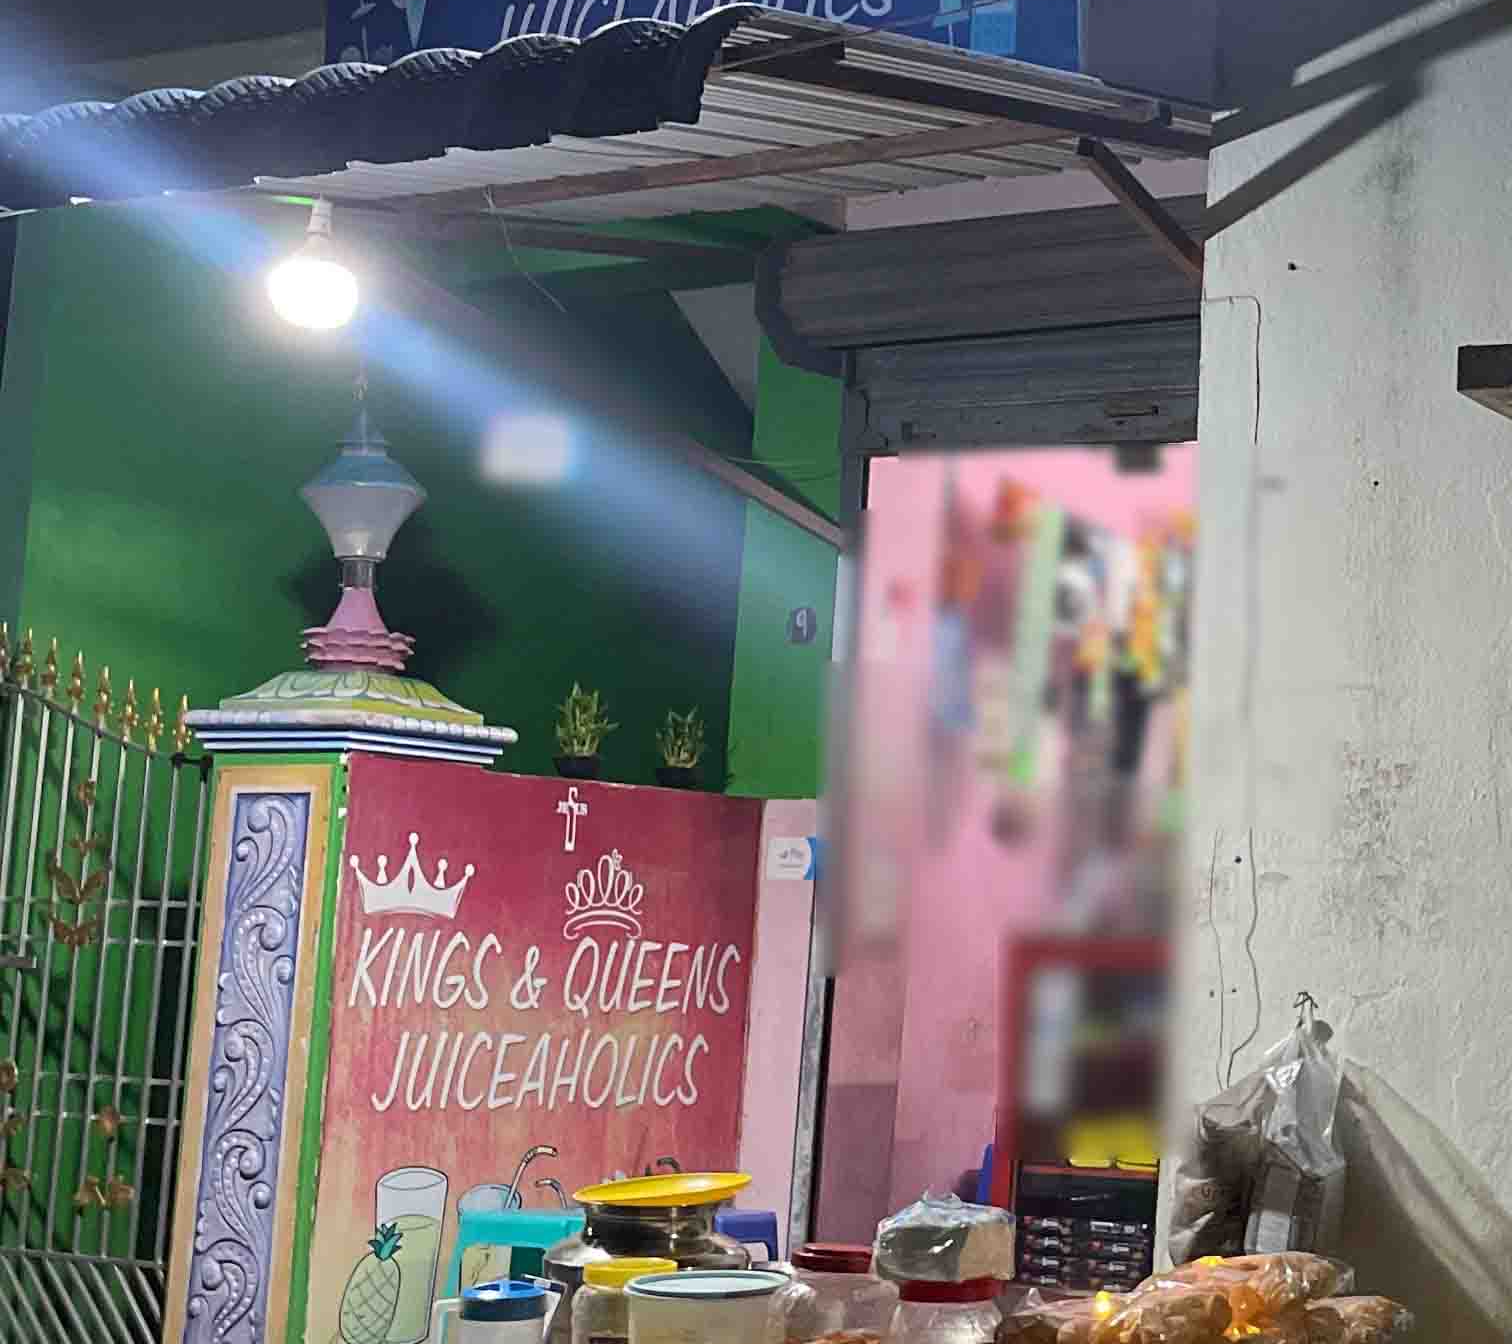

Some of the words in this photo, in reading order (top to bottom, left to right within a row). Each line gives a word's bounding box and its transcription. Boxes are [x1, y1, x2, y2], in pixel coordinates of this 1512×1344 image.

[347, 927, 502, 1011] KINGS
[509, 944, 547, 1011] &
[562, 937, 742, 1019] QUEENS
[370, 1030, 710, 1113] JUICEAHOLICS
